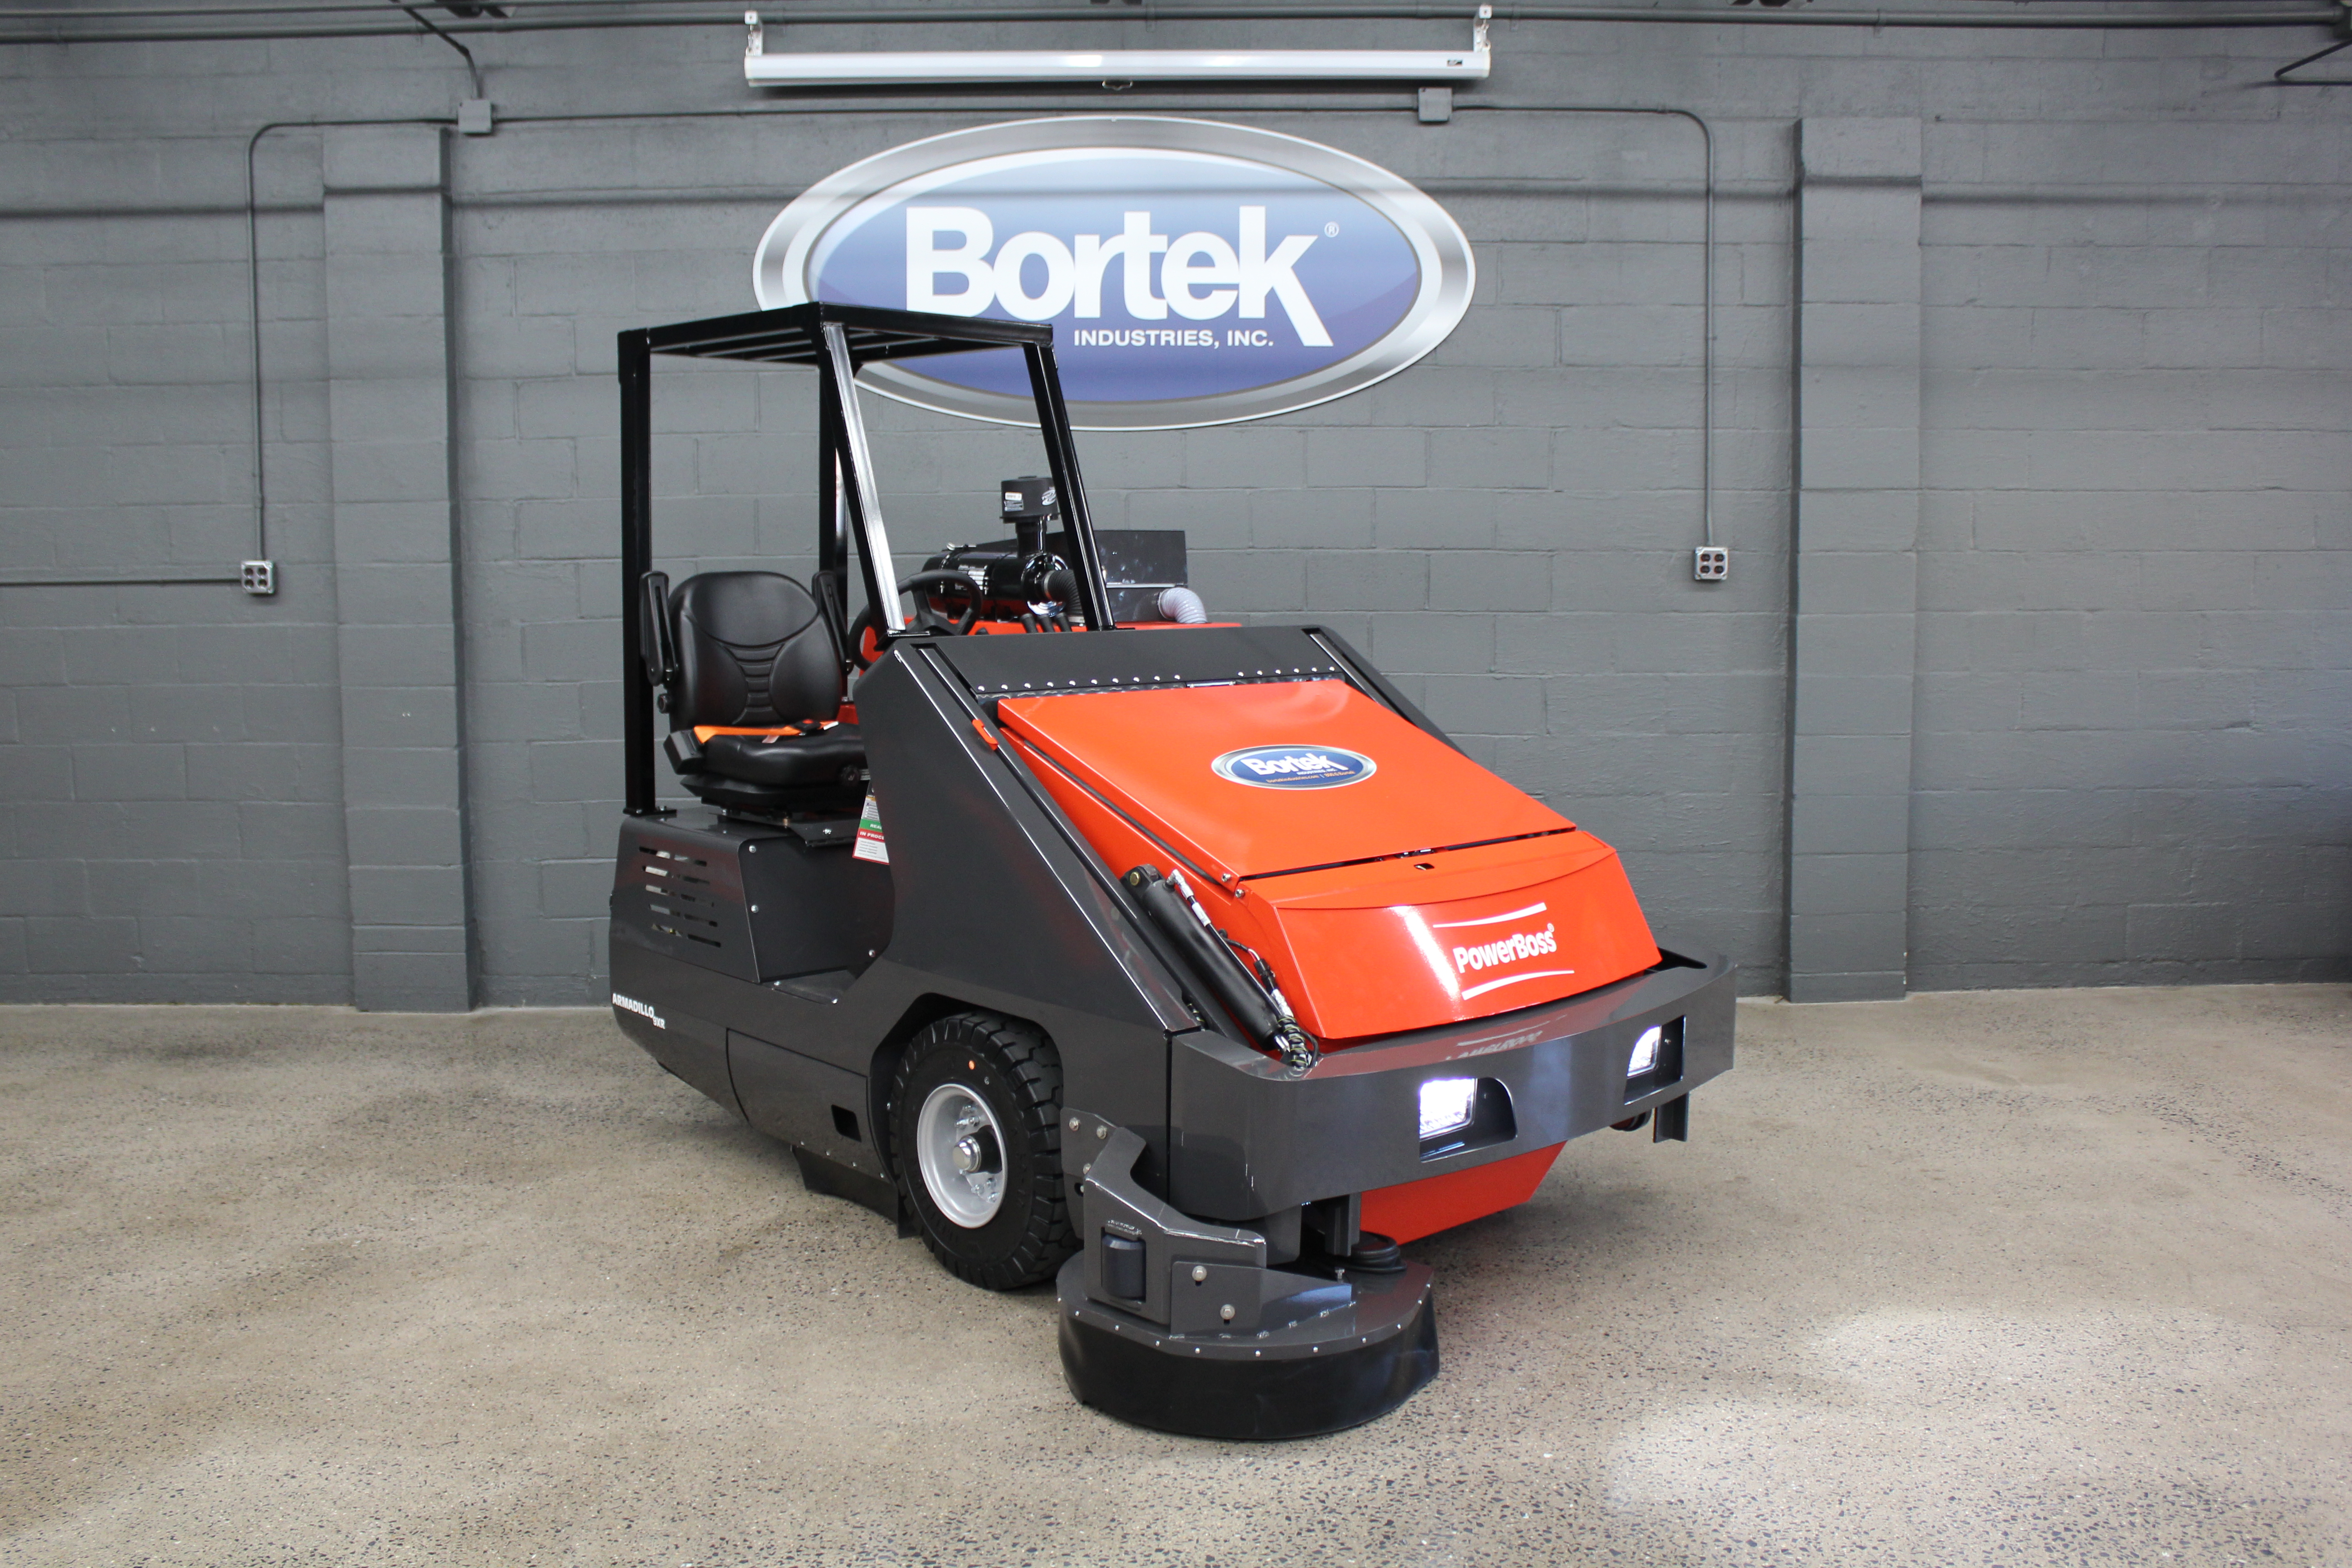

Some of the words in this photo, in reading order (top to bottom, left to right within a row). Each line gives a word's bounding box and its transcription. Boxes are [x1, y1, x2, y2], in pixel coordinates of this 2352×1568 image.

[1074, 329, 1220, 349] INDUSTRIES,
[1227, 329, 1274, 347] INC.
[1240, 753, 1349, 775] Bortek
[612, 993, 654, 1019] ARMADILLO
[652, 1016, 666, 1030] 9XR
